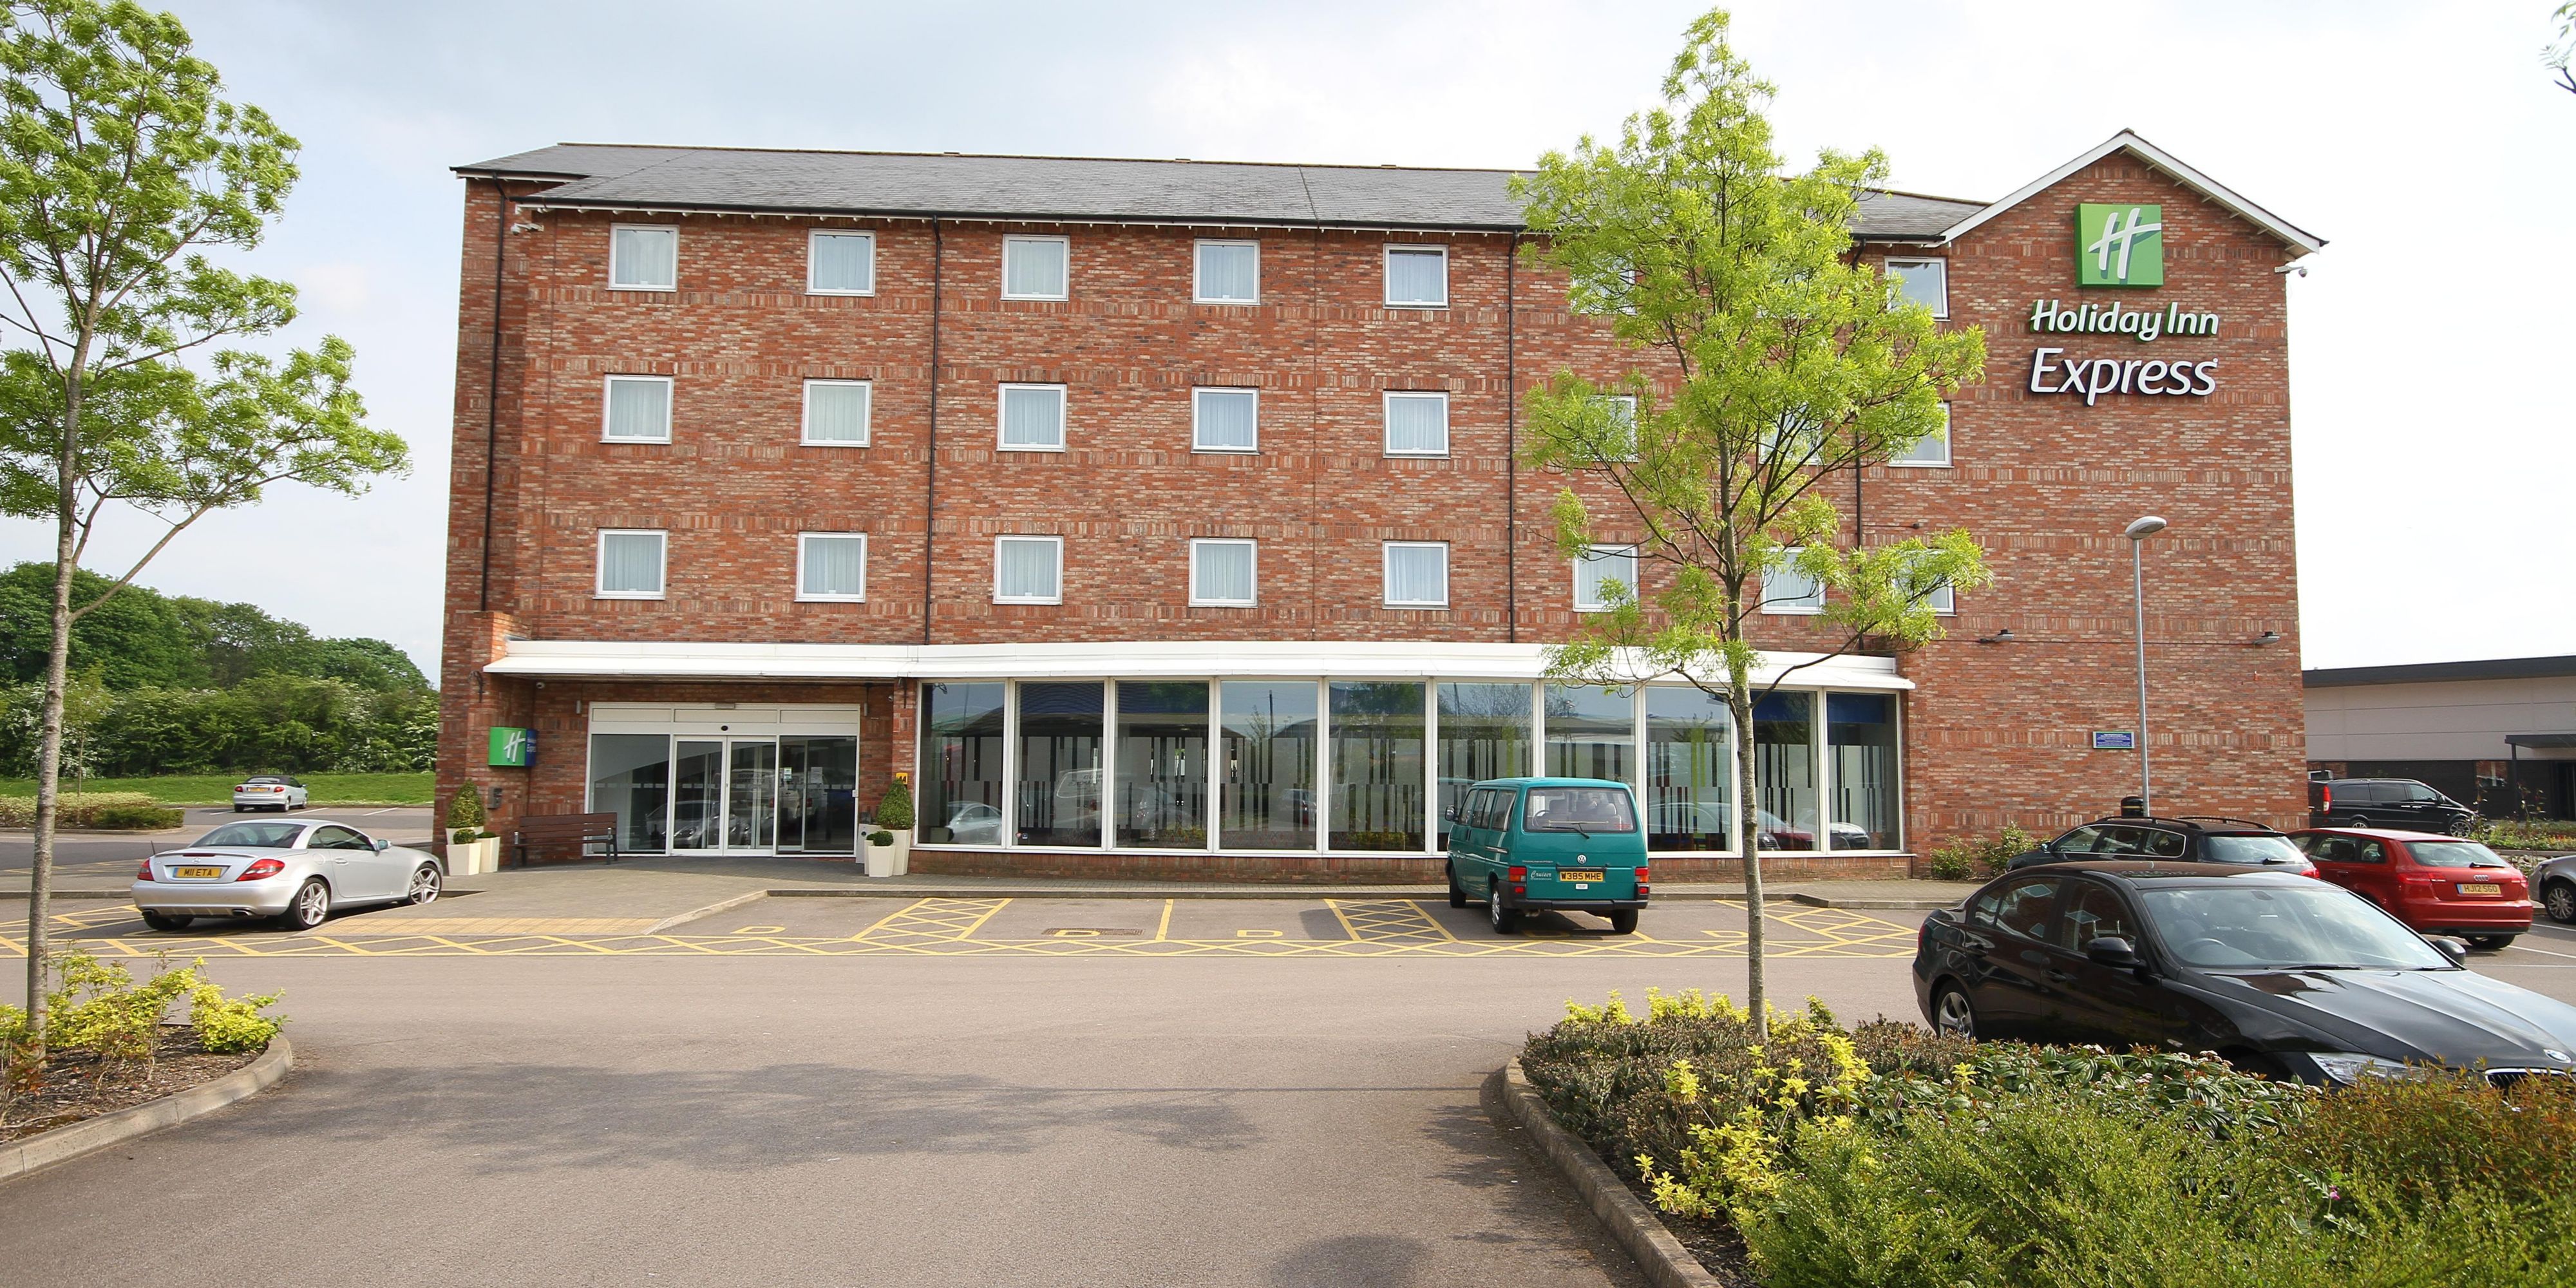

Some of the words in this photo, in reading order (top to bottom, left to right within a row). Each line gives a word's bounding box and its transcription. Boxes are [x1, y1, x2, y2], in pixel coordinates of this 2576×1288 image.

[2030, 299, 2162, 342] Holiday
[2165, 301, 2219, 336] Inn
[2029, 347, 2219, 406] Express
[195, 868, 213, 876] ETA
[1530, 870, 1551, 878] Cruiser
[1560, 872, 1584, 880] W385
[1584, 872, 1602, 880] MHE
